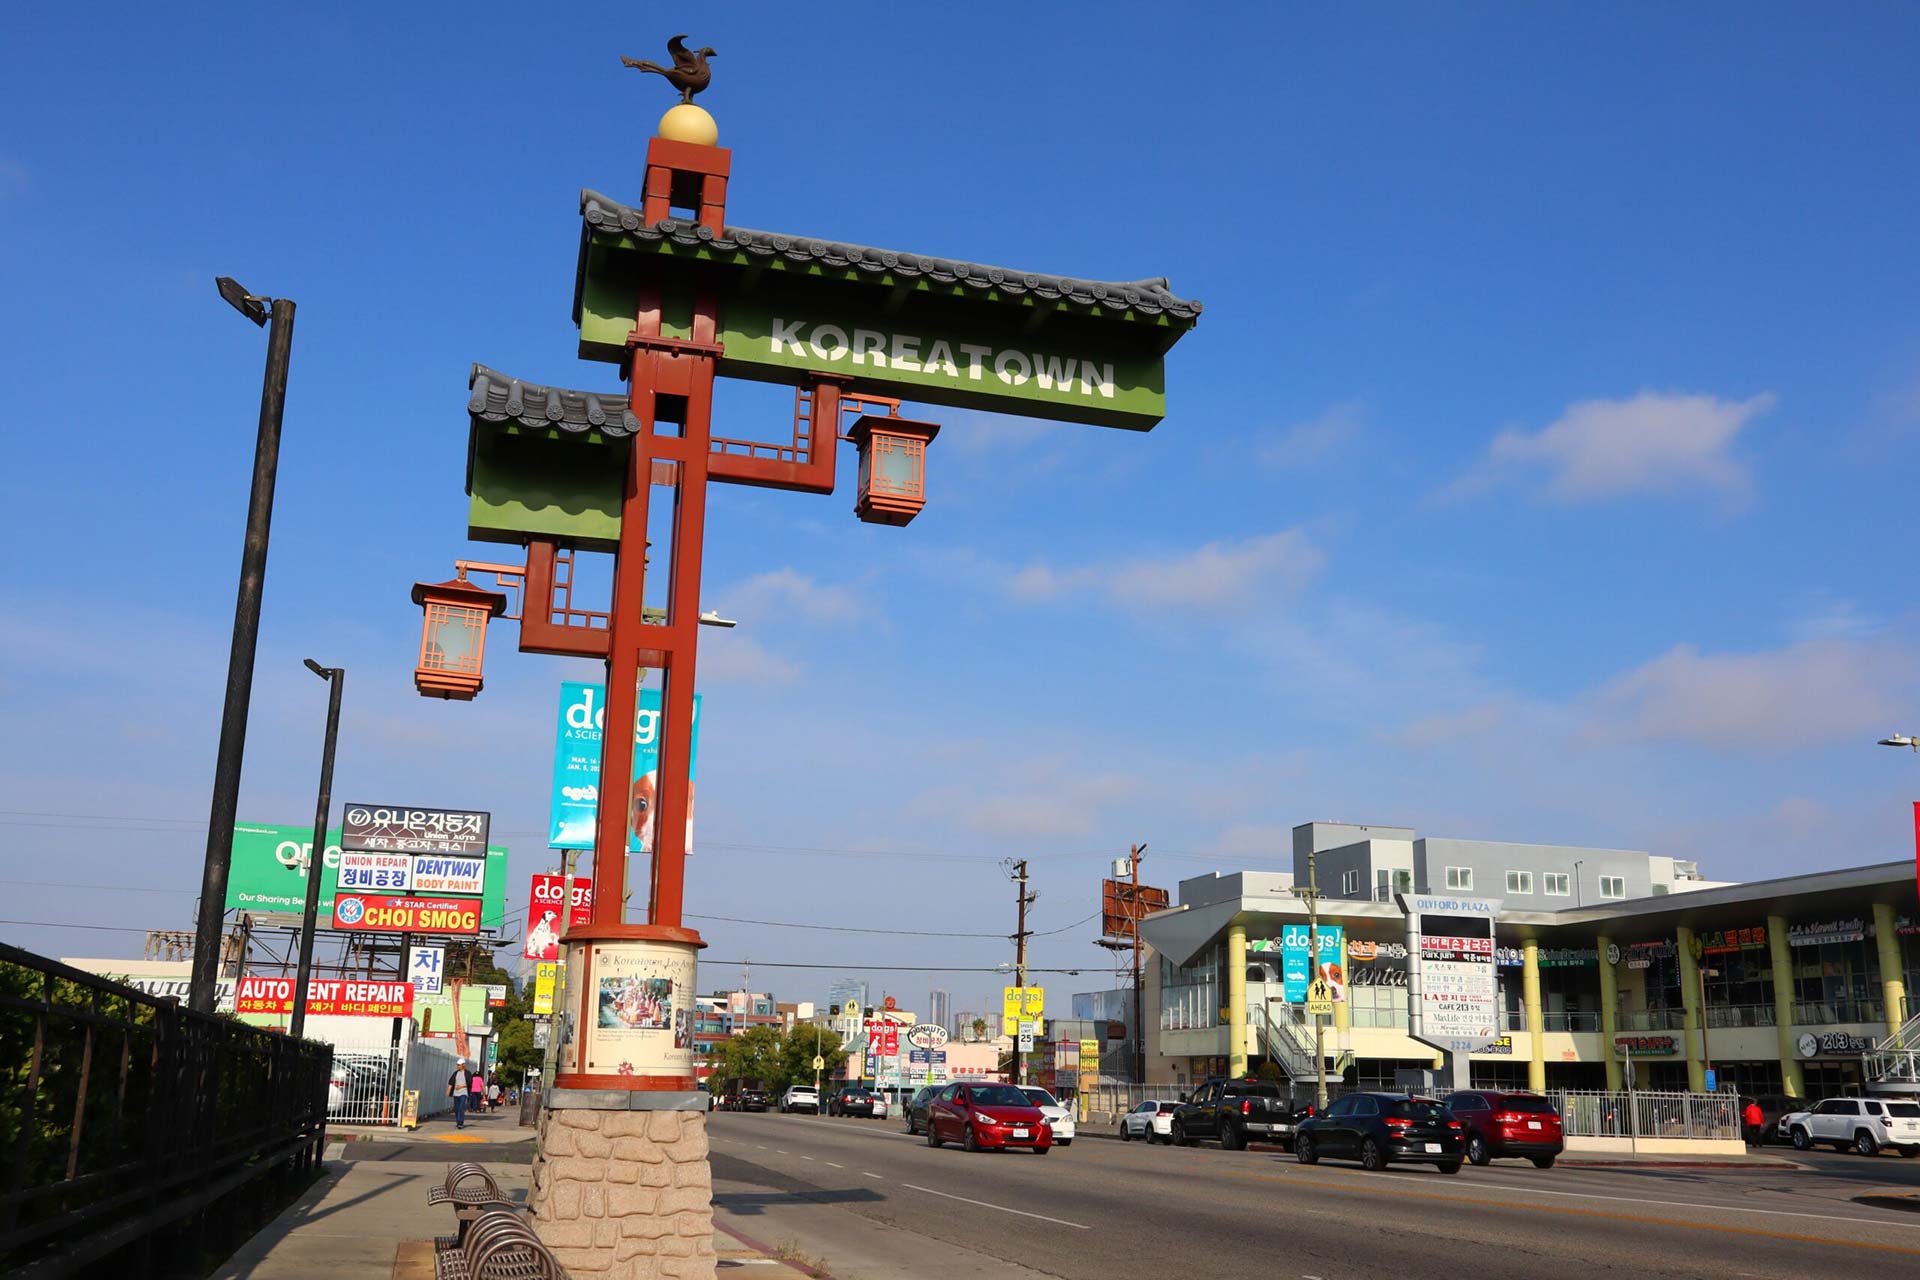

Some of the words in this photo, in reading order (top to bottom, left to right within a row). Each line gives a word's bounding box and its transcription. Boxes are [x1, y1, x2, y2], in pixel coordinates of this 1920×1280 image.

[771, 318, 1114, 398] KOREATOWN
[564, 730, 572, 738] A
[373, 809, 482, 833] 유니온자동차
[424, 832, 448, 840] Union
[345, 856, 372, 866] UNION
[376, 857, 408, 867] REPAIR
[416, 859, 481, 879] DENTWAY
[344, 869, 406, 887] 정비공장
[416, 879, 444, 889] BODY
[448, 880, 479, 890] PAINT
[256, 894, 290, 905] Sharing
[1417, 900, 1458, 910] OLYFORD
[1462, 902, 1490, 912] PLAZA
[365, 908, 413, 927] CHOI
[419, 911, 475, 929] SMOG
[1286, 928, 1340, 951] dogs!
[414, 950, 440, 972] 차
[241, 980, 289, 999] AUTO
[307, 982, 340, 1000] ENT
[345, 984, 405, 1003] REPAIR
[1007, 989, 1042, 1004] dogs!
[240, 1001, 277, 1010] 자동차
[310, 1002, 334, 1010] 제거
[342, 1003, 364, 1012] 바디
[368, 1004, 403, 1014] 페인트
[871, 1022, 898, 1034] dogs!
[1451, 1041, 1472, 1050] 3224
